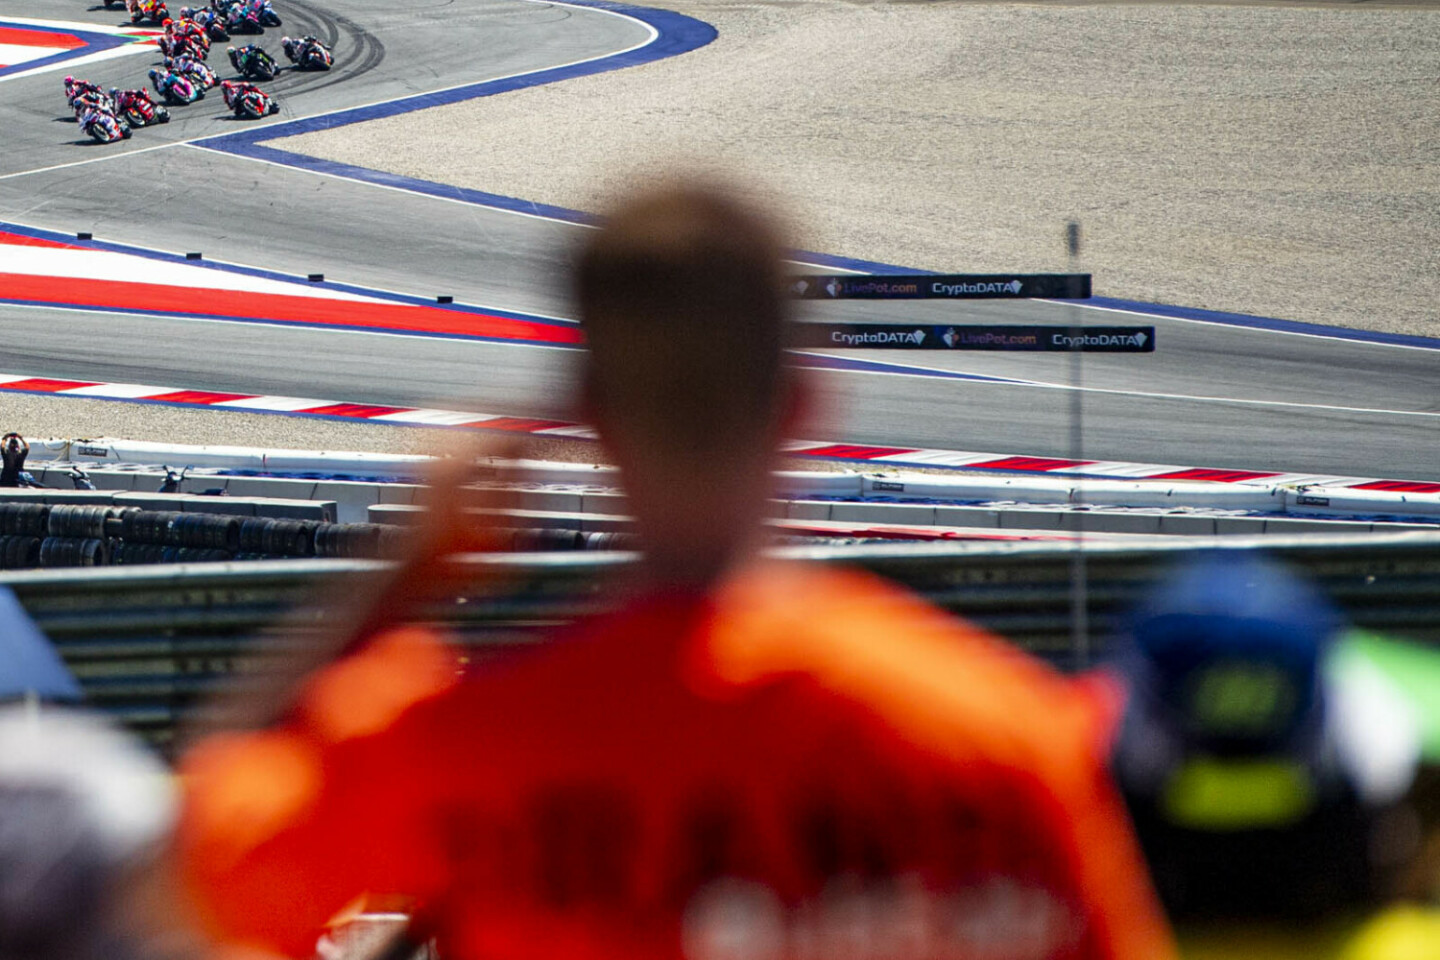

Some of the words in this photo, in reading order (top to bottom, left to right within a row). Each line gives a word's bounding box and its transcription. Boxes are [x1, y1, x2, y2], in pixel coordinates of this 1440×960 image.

[844, 282, 918, 293] LivePot.com
[932, 282, 1011, 295] CryptoDATA
[831, 331, 915, 345] CryptoDATA
[961, 332, 1037, 344] LivePot.com
[1052, 333, 1137, 347] CryptoDATA
